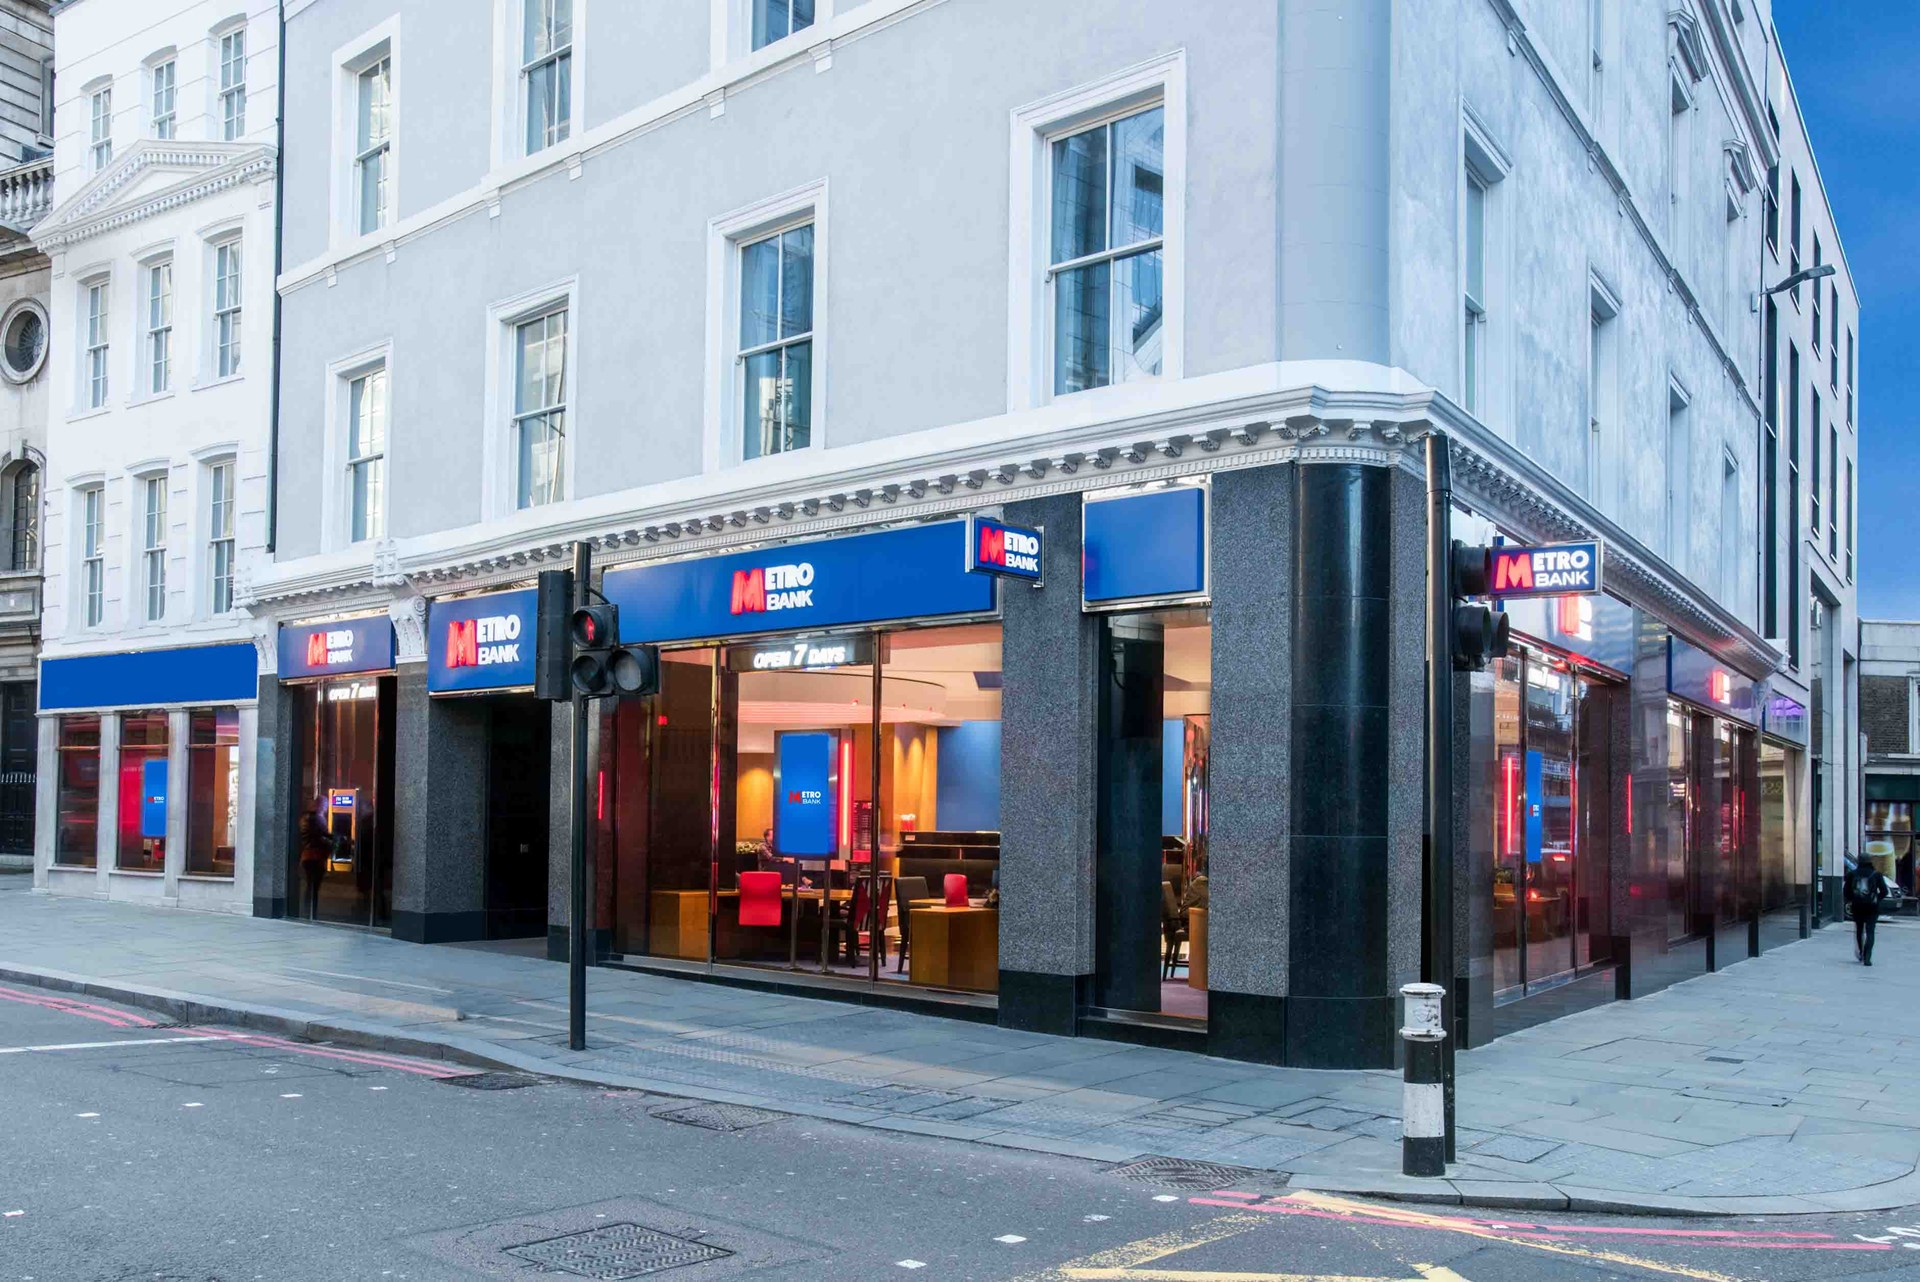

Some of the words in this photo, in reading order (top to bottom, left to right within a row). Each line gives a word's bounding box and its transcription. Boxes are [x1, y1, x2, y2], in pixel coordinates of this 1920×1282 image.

[980, 526, 1039, 566] METRO
[1005, 552, 1039, 572] BANK
[1495, 550, 1590, 590] METRO
[731, 562, 815, 615] METRO
[1535, 570, 1590, 588] BANK
[766, 589, 814, 611] BANK
[446, 614, 521, 668] METRO
[478, 644, 520, 665] BANK
[753, 650, 792, 669] OPEN
[793, 643, 809, 666] 7
[808, 646, 847, 665] DAYS
[789, 791, 822, 804] METRO
